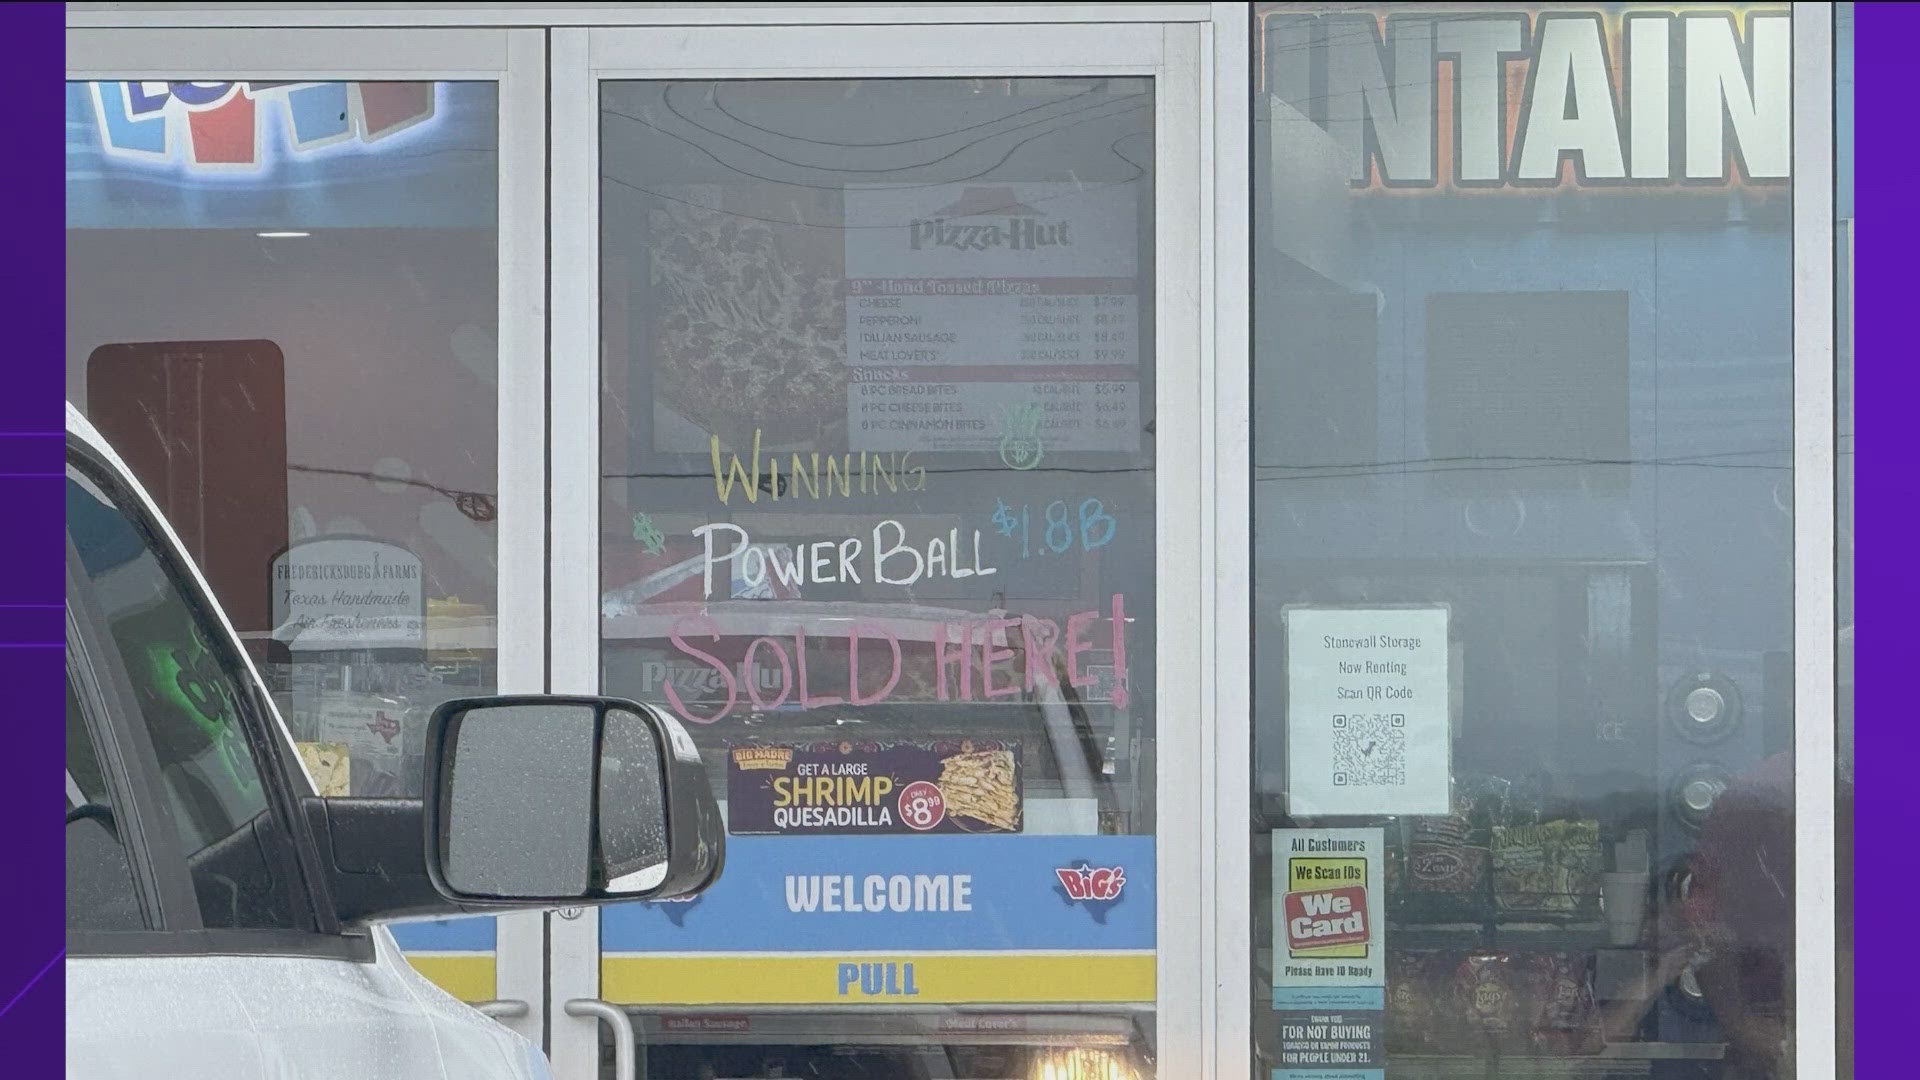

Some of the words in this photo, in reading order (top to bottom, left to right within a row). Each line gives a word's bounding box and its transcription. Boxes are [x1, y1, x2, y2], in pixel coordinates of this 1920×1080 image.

[910, 218, 1003, 250] Pizza
[1008, 217, 1073, 250] Hut
[860, 298, 901, 308] CHEESE
[859, 315, 921, 326] PEPPERONI
[859, 333, 902, 343] ITALIAN
[904, 333, 957, 343] SAUSAGE
[859, 350, 888, 361] MEAT
[852, 366, 909, 382] Snacks
[888, 385, 926, 396] BREAD
[888, 403, 932, 414] CHEESE
[889, 420, 954, 431] CINNAMON
[710, 428, 927, 505] WINNING
[383, 564, 418, 580] FARMS
[283, 588, 327, 607] Texas
[1323, 635, 1376, 649] Stonewall
[1379, 635, 1422, 650] Storage
[664, 615, 903, 724] SOLD
[934, 593, 1130, 710] HERE!
[1338, 661, 1362, 674] Now
[1365, 660, 1407, 676] Renting
[736, 661, 791, 693] Hu
[1337, 686, 1363, 700] Scan
[1366, 686, 1382, 701] QR
[1385, 686, 1413, 699] Code
[797, 763, 820, 776] GET
[821, 763, 830, 776] A
[831, 763, 868, 776] LARGE
[773, 776, 892, 806] SHRIMP
[773, 806, 892, 829] QUESADILLA
[1291, 838, 1305, 851] All
[1308, 838, 1366, 852] Customers
[1296, 866, 1312, 879] We
[1314, 865, 1341, 880] Scan
[1343, 865, 1361, 879] IDs
[785, 873, 973, 913] WELCOME
[1300, 892, 1352, 917] We
[1290, 911, 1364, 939] Card
[837, 963, 920, 995] PULL
[1285, 966, 1312, 977] Please
[1315, 966, 1333, 977] Have
[1336, 966, 1346, 977] ID
[1348, 965, 1373, 978] Ready
[1331, 1015, 1343, 1023] YOU
[1282, 1026, 1304, 1039] FOR
[1307, 1026, 1328, 1039] NOT
[1331, 1025, 1371, 1039] BUYING
[1283, 1041, 1309, 1050] TOBACCO
[1311, 1041, 1319, 1050] OR
[1340, 1041, 1371, 1050] PRODUCTS
[1282, 1052, 1298, 1064] FOR
[1299, 1052, 1329, 1063] PEOPLE
[1330, 1052, 1357, 1063] UNDER
